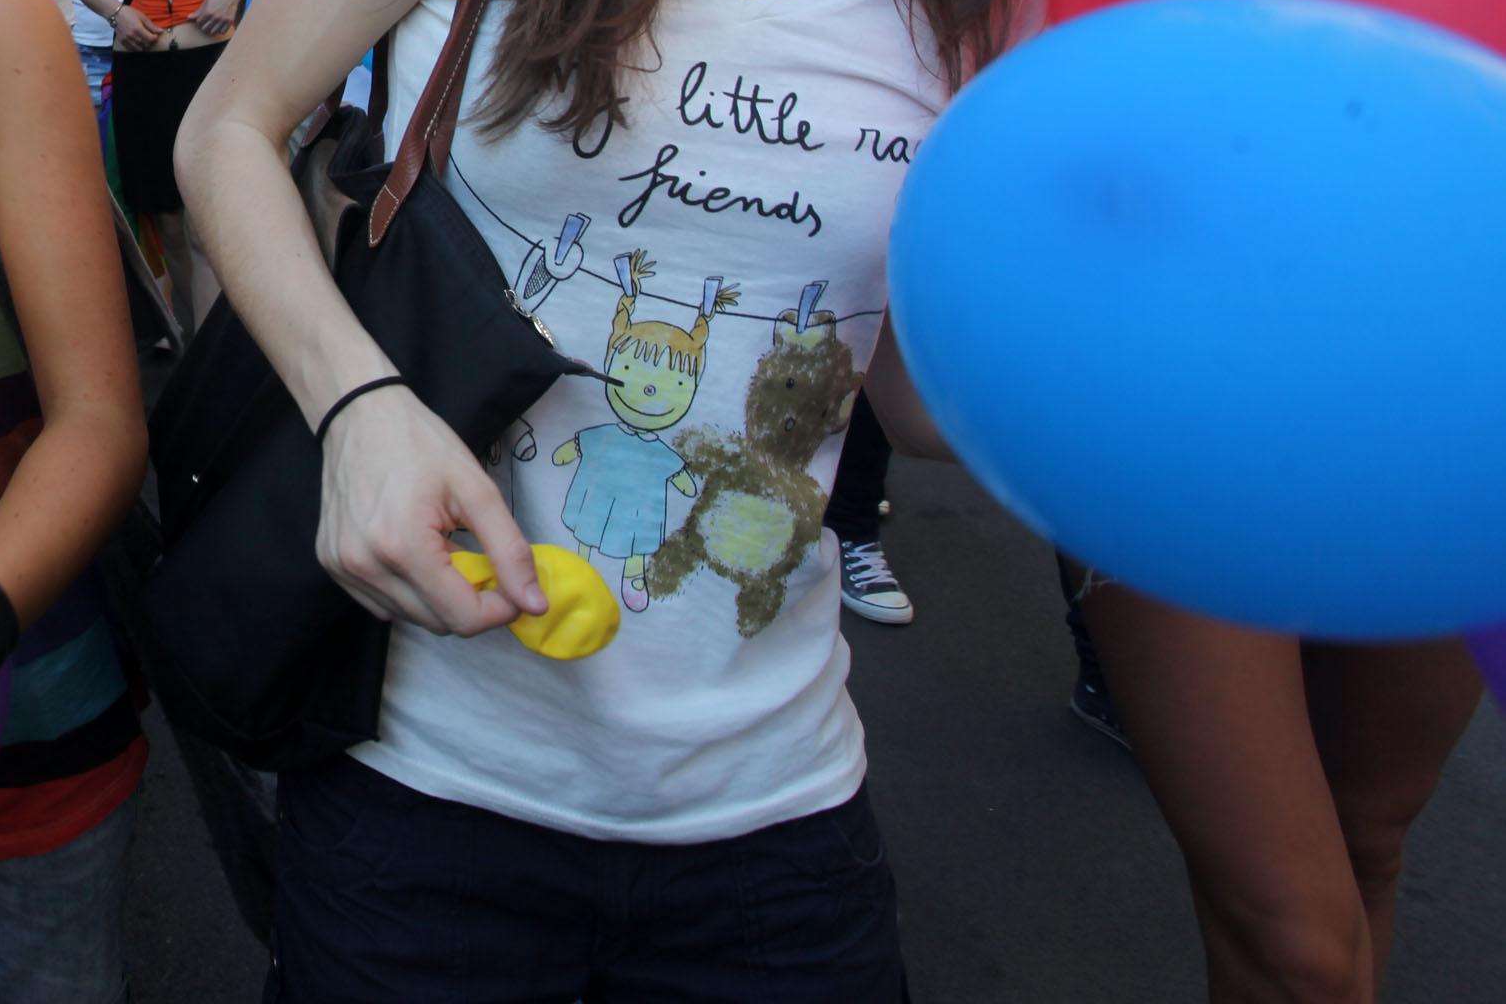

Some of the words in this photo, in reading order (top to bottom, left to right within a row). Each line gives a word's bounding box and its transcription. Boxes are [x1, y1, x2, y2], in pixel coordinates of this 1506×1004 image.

[675, 61, 824, 151] little
[854, 127, 923, 165] ra
[618, 144, 822, 238] friends
